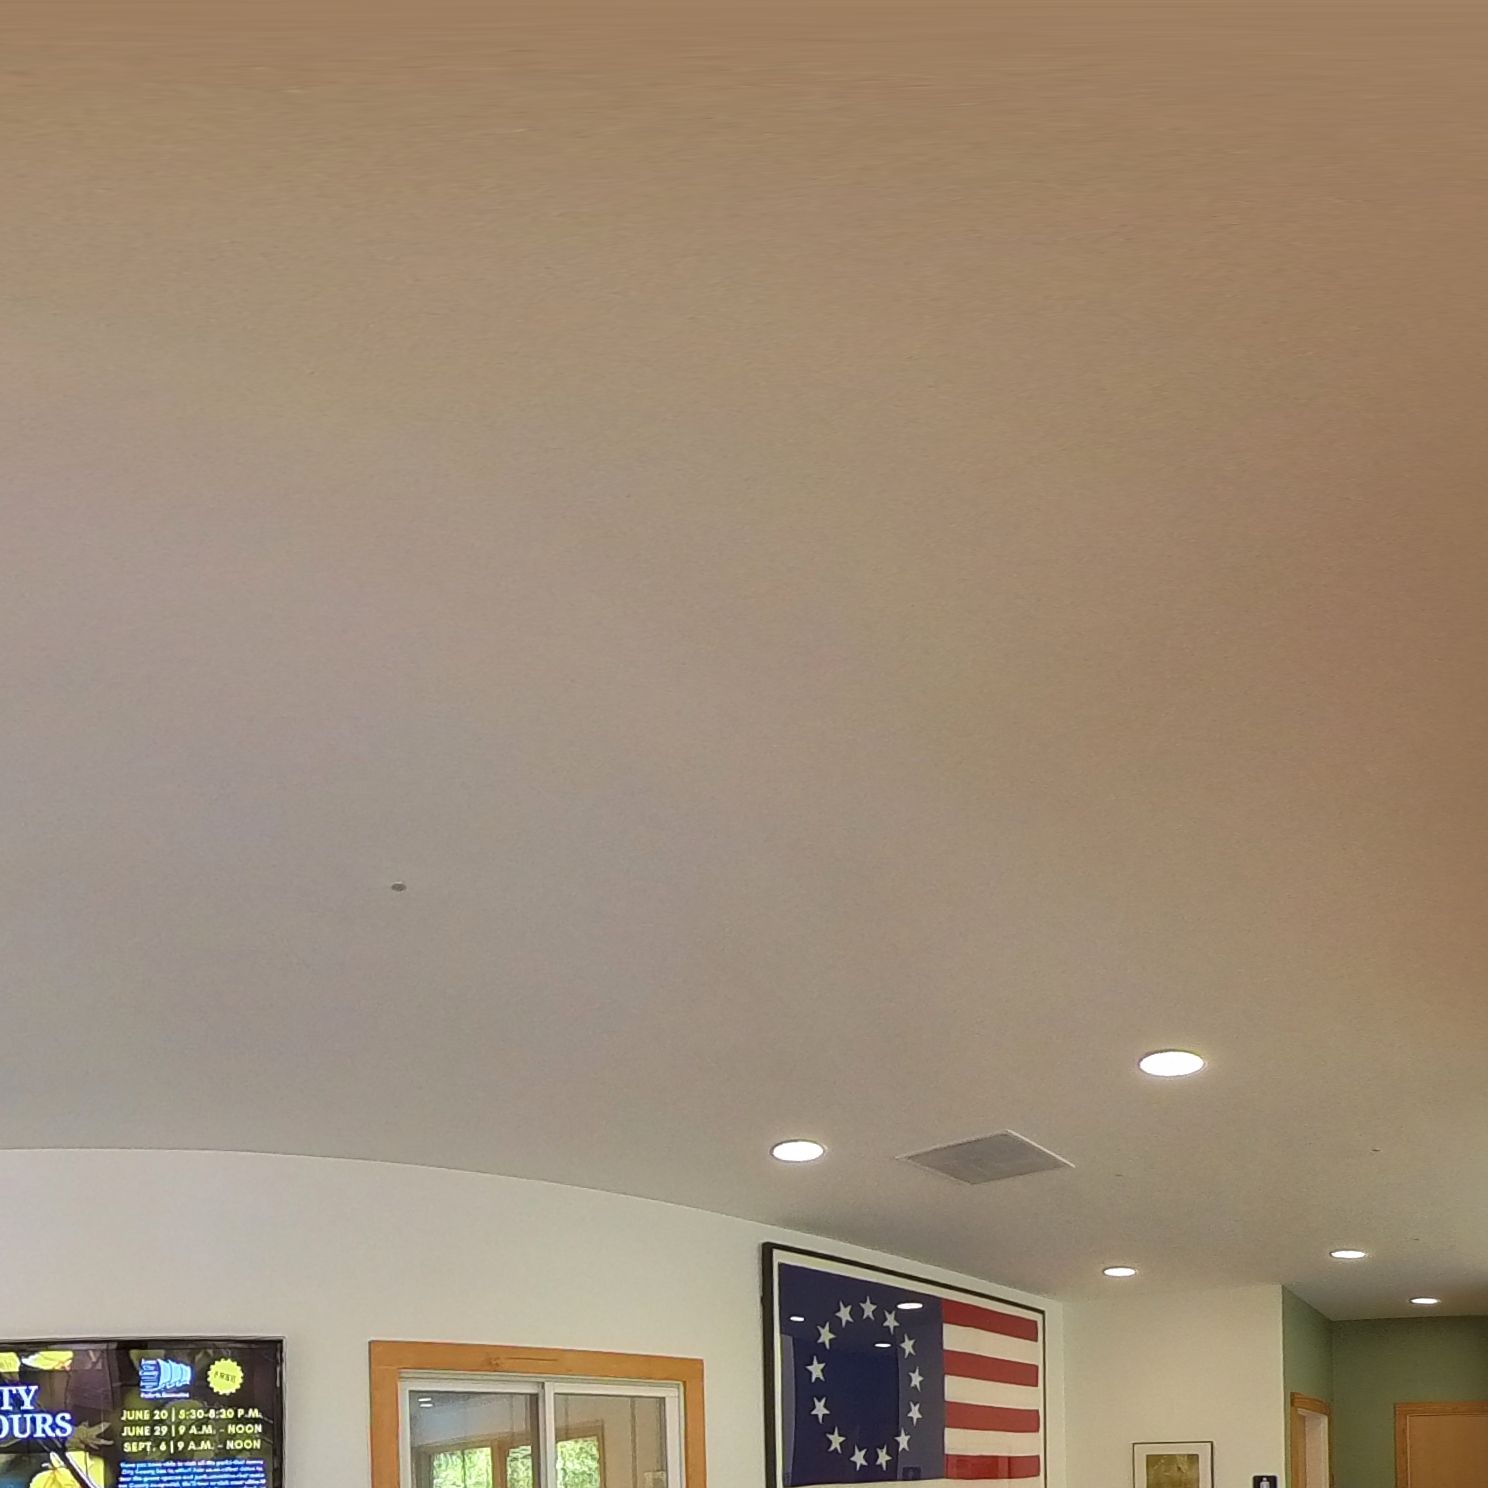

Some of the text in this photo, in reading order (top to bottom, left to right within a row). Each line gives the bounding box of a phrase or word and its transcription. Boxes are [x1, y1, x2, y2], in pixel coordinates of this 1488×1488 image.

[121, 1410, 151, 1421] JUNE
[153, 1409, 168, 1420] 20
[121, 1425, 151, 1436] JUNE
[153, 1425, 168, 1436] 29
[227, 1423, 263, 1434] NOON
[226, 1439, 261, 1450] NOON
